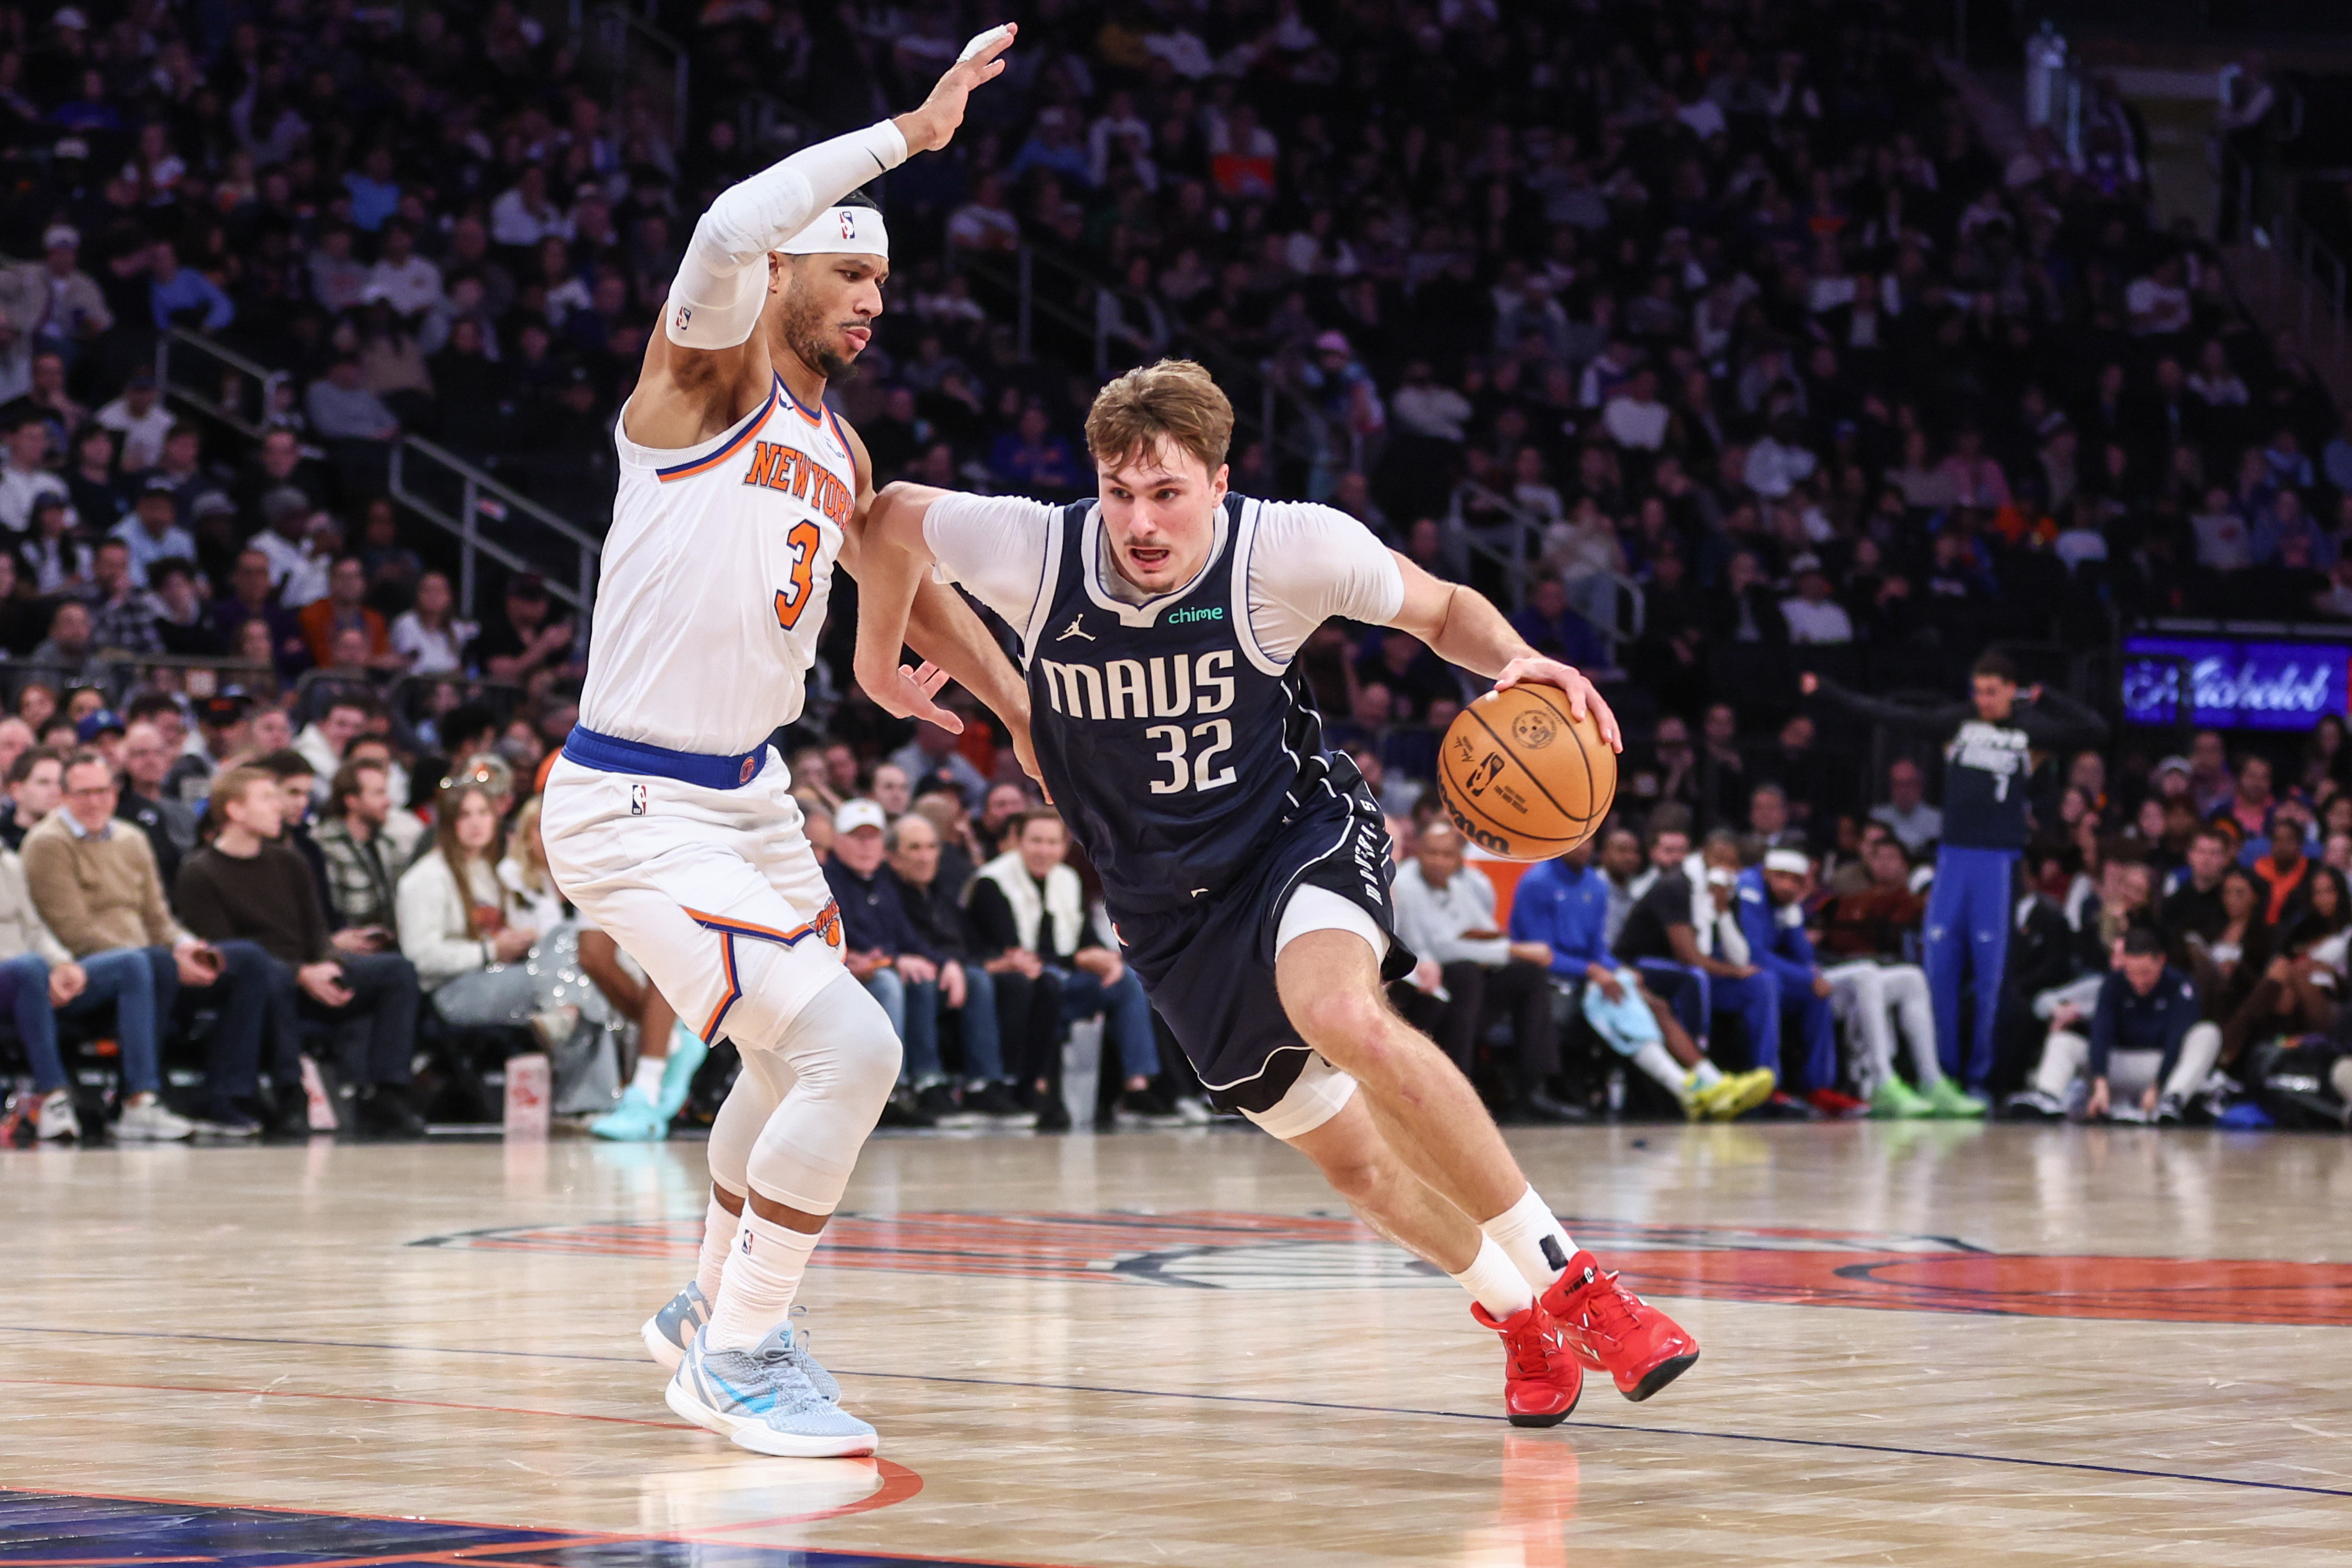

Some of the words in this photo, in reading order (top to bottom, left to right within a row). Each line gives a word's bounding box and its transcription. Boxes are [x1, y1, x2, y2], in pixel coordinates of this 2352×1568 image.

[774, 519, 821, 631] 3
[1168, 606, 1224, 624] chime
[1040, 650, 1236, 720] MAVS
[1146, 718, 1237, 795] 32
